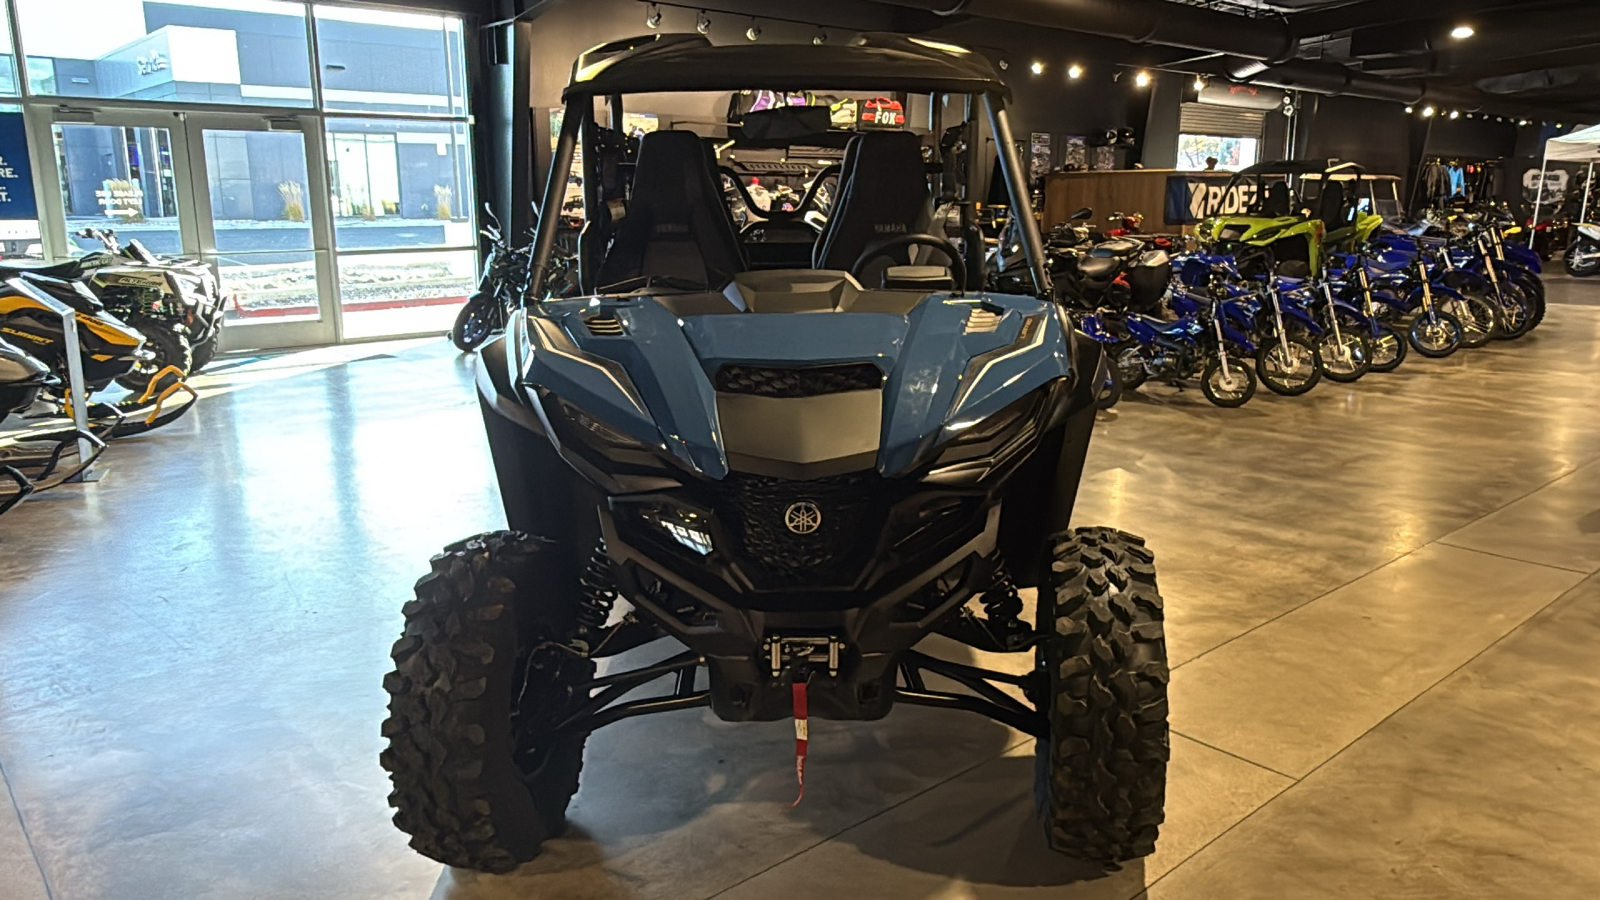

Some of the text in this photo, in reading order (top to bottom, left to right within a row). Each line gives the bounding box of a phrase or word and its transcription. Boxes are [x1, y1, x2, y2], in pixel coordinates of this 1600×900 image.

[874, 111, 896, 125] FOX
[0, 168, 18, 178] RE.
[874, 222, 907, 233] YAMAHA
[1, 327, 54, 344] SUMMIT
